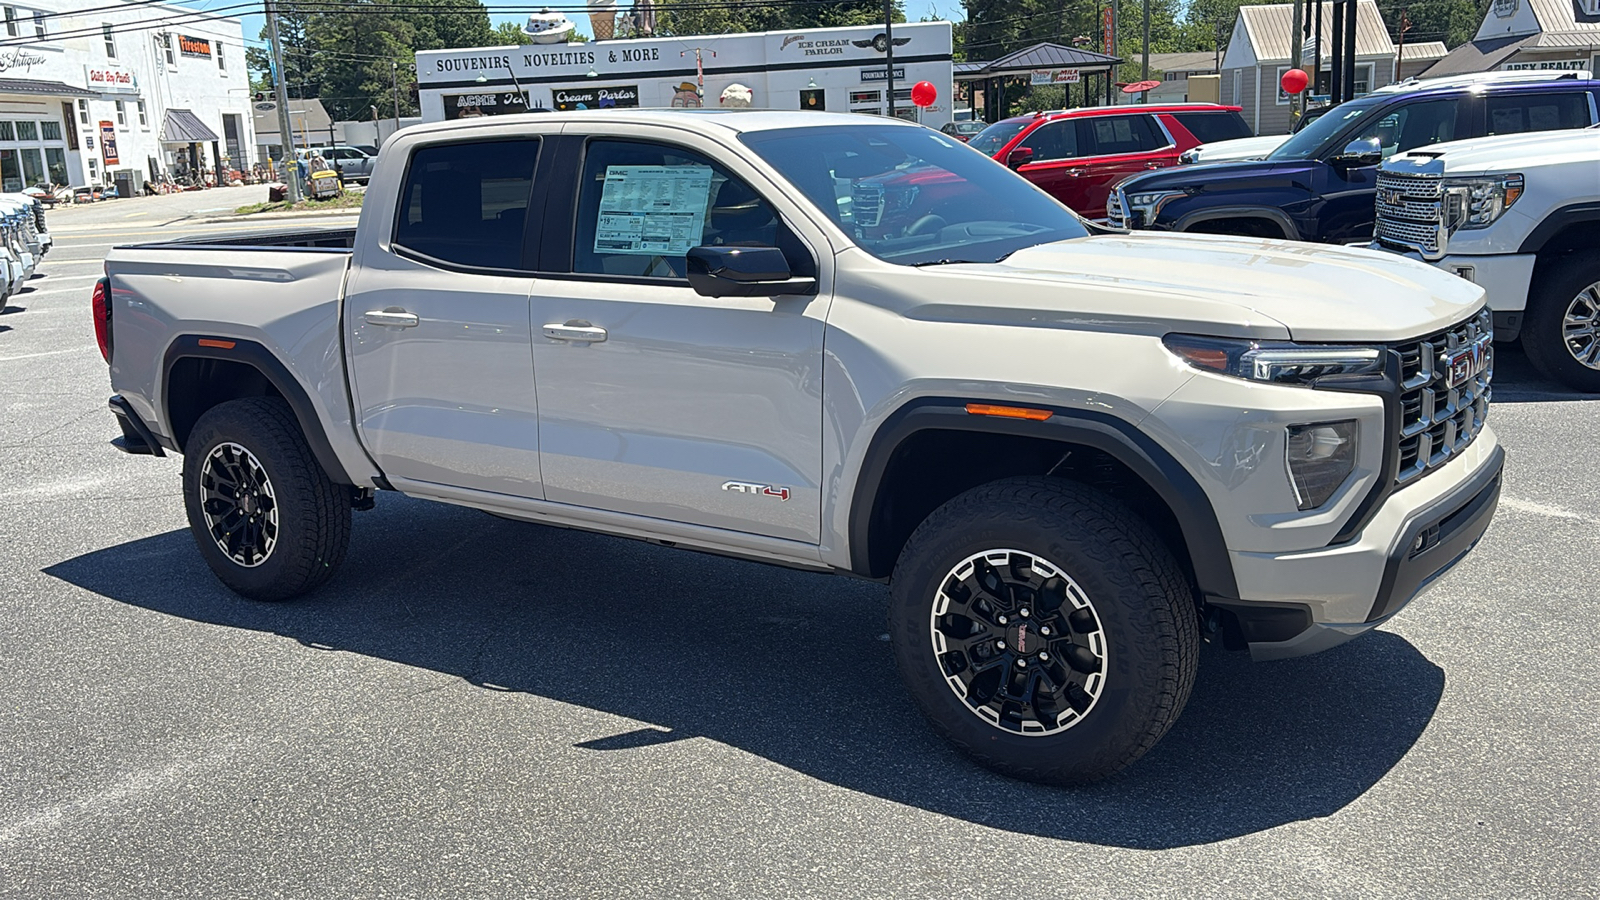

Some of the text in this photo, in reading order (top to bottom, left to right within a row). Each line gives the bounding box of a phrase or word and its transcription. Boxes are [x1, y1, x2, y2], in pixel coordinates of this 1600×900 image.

[178, 34, 210, 54] Firestone
[798, 41, 814, 49] ICE
[815, 39, 850, 48] CREAM
[804, 47, 843, 56] PARLOR
[6, 46, 47, 73] Antiques
[436, 48, 659, 72] SOUVENIRS NOVELTIES & MORE
[1540, 60, 1586, 71] REALTY
[90, 69, 105, 82] Dutch
[105, 70, 115, 85] Boy
[862, 71, 885, 79] FOUNTAIN
[457, 94, 497, 107] ACME
[556, 89, 636, 103] Cream Parlor
[603, 217, 611, 225] 19
[1446, 335, 1491, 389] GMC
[721, 480, 791, 502] AT4
